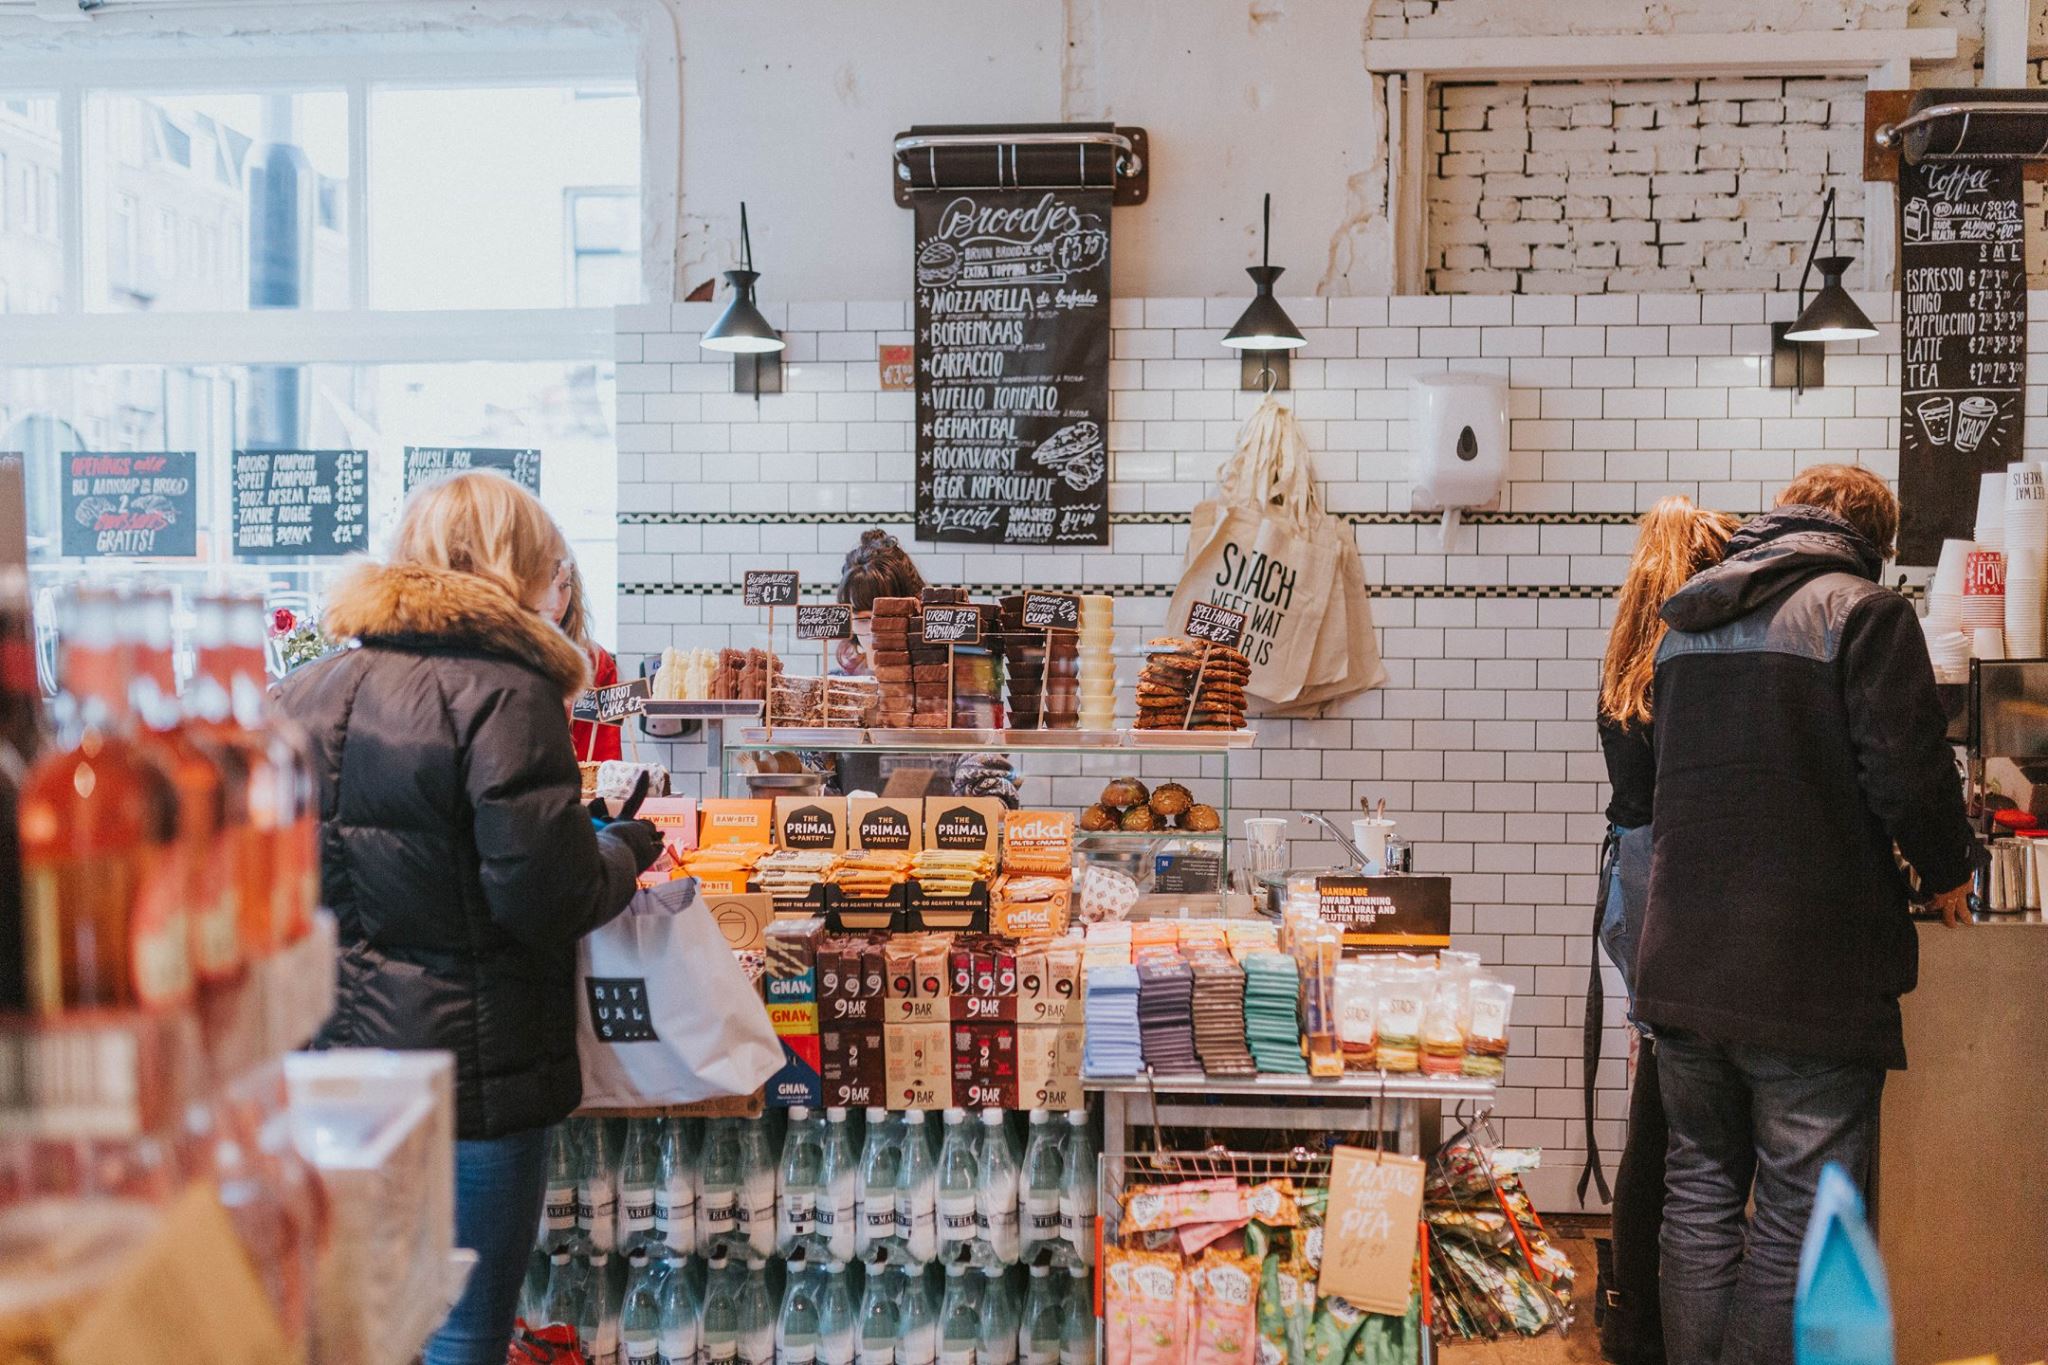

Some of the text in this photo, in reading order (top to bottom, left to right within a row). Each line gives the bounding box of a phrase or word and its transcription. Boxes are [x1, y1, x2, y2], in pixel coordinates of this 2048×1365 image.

[1988, 200, 2018, 212] SOYA
[939, 193, 1101, 247] Broodjes
[1984, 211, 2017, 220] MILK
[1961, 220, 1996, 231] ALMOND
[1980, 244, 2019, 258] S M L
[964, 266, 989, 279] EXTRA
[1906, 267, 1964, 293] ESPRESSO
[931, 287, 1034, 315] MOZZARELLA
[1907, 293, 1942, 315] LUNGO
[1906, 312, 1976, 337] CAPPUCCINO
[931, 320, 1024, 347] BOERENKAAS
[1907, 336, 1943, 363] LATTE
[931, 351, 1004, 379] CARPACCIO
[1907, 363, 1939, 388] TEA
[931, 385, 1058, 411] VITELLO TONNATO
[933, 417, 1018, 440] GEHAKTBAL
[933, 446, 1019, 470] ROOKWORST
[970, 475, 1057, 501] KIPROLLADE
[118, 494, 130, 514] 2
[239, 506, 274, 525] TARWE
[1008, 506, 1057, 523] SMASHED
[1005, 521, 1053, 538] AVOCADO
[1216, 542, 1297, 610] STACH
[926, 609, 954, 622] URBAN
[1025, 612, 1054, 624] CUPS
[1250, 604, 1286, 639] WAT
[798, 624, 840, 637] WALNOTEN
[1253, 639, 1274, 667] IS
[600, 683, 633, 704] CARROT
[803, 815, 819, 823] THE
[878, 816, 893, 824] THE
[954, 816, 969, 824] THE
[786, 822, 834, 835] PRIMAL
[862, 824, 909, 836] PRIMAL
[938, 824, 986, 836] PRIMAL
[872, 836, 899, 844] PANTRY
[948, 836, 976, 844] PANTRY
[1321, 887, 1368, 896] HANDMADE
[1321, 896, 1391, 906] AWARD WINNING
[1321, 905, 1397, 915] ALL NATURAL AND
[1321, 914, 1376, 923] GLUTEN FREE
[770, 981, 812, 995] GNAW
[772, 1009, 811, 1023] GNAW
[778, 1082, 810, 1096] GNAW
[1340, 1209, 1390, 1240] PEA
